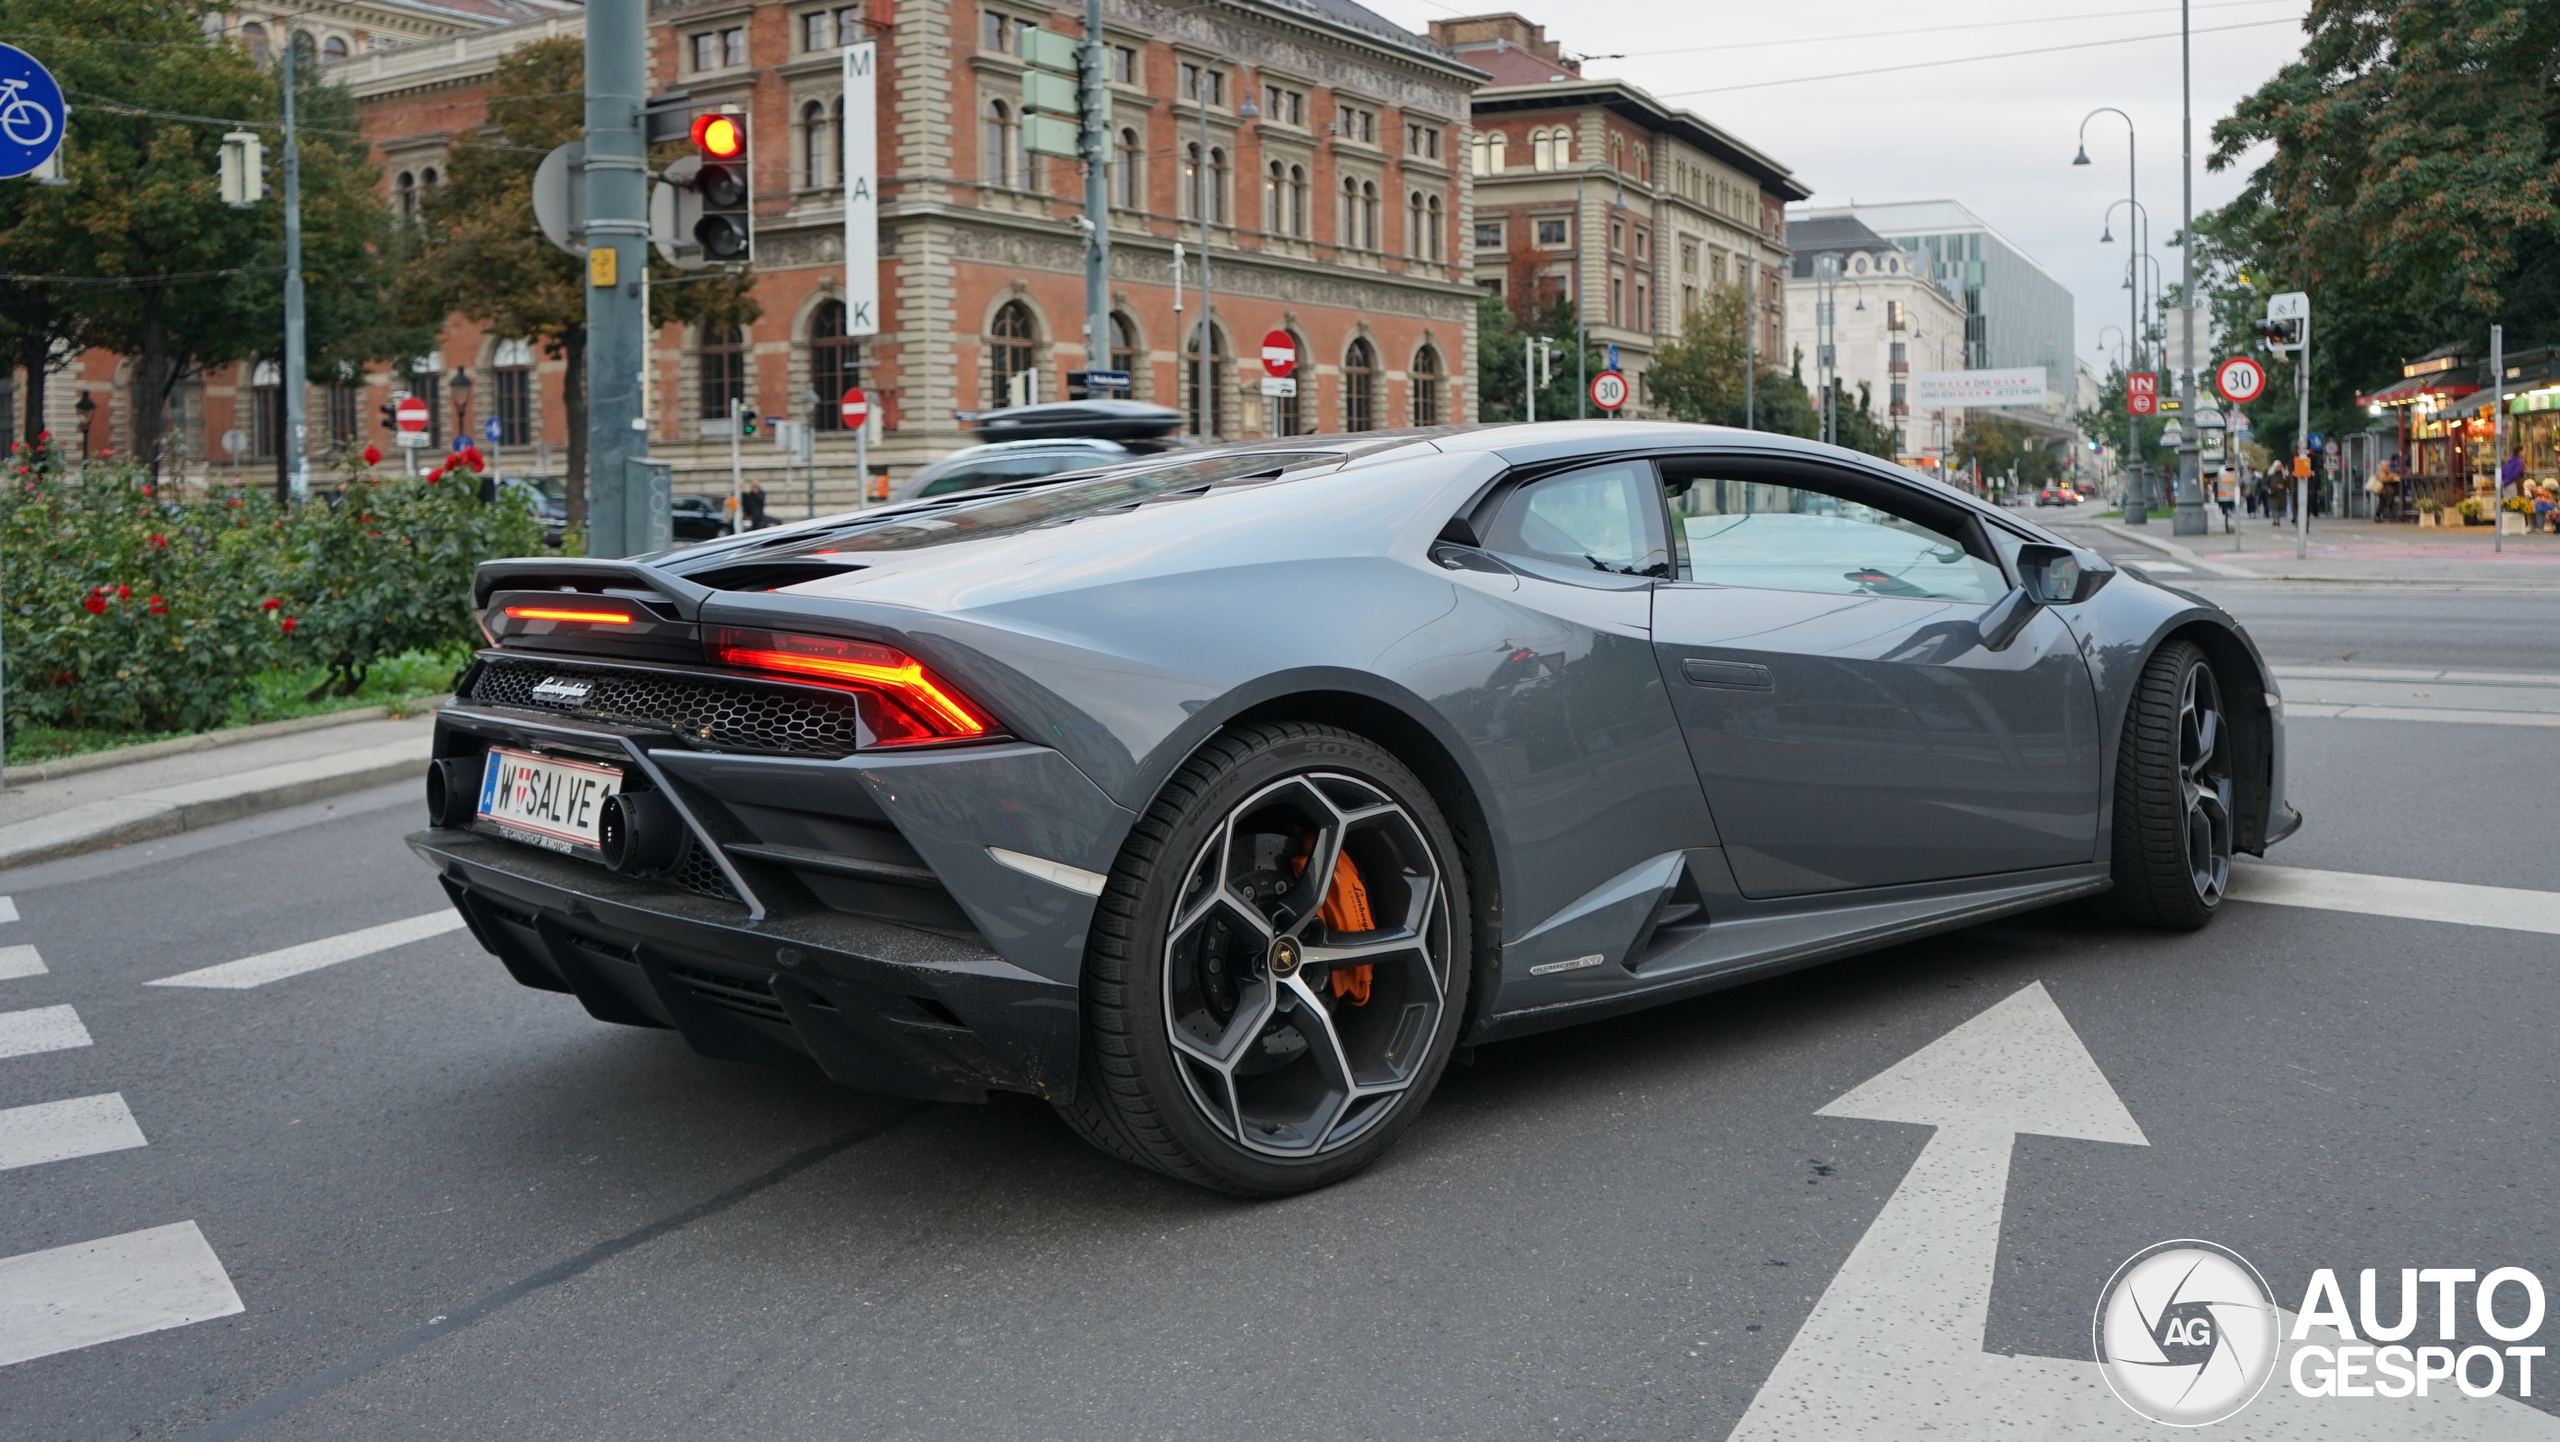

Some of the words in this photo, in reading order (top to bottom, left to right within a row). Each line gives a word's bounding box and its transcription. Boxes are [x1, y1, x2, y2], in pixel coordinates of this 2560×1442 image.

[1601, 381, 1619, 400] 30
[1974, 379, 1991, 388] DAS
[2130, 377, 2153, 391] IN
[2229, 370, 2252, 391] 30
[484, 791, 491, 805] A
[498, 763, 516, 810] W
[526, 769, 596, 828] SALVE
[1187, 772, 1240, 828] WINTER
[500, 825, 511, 838] THE
[548, 837, 573, 854] MOTORS
